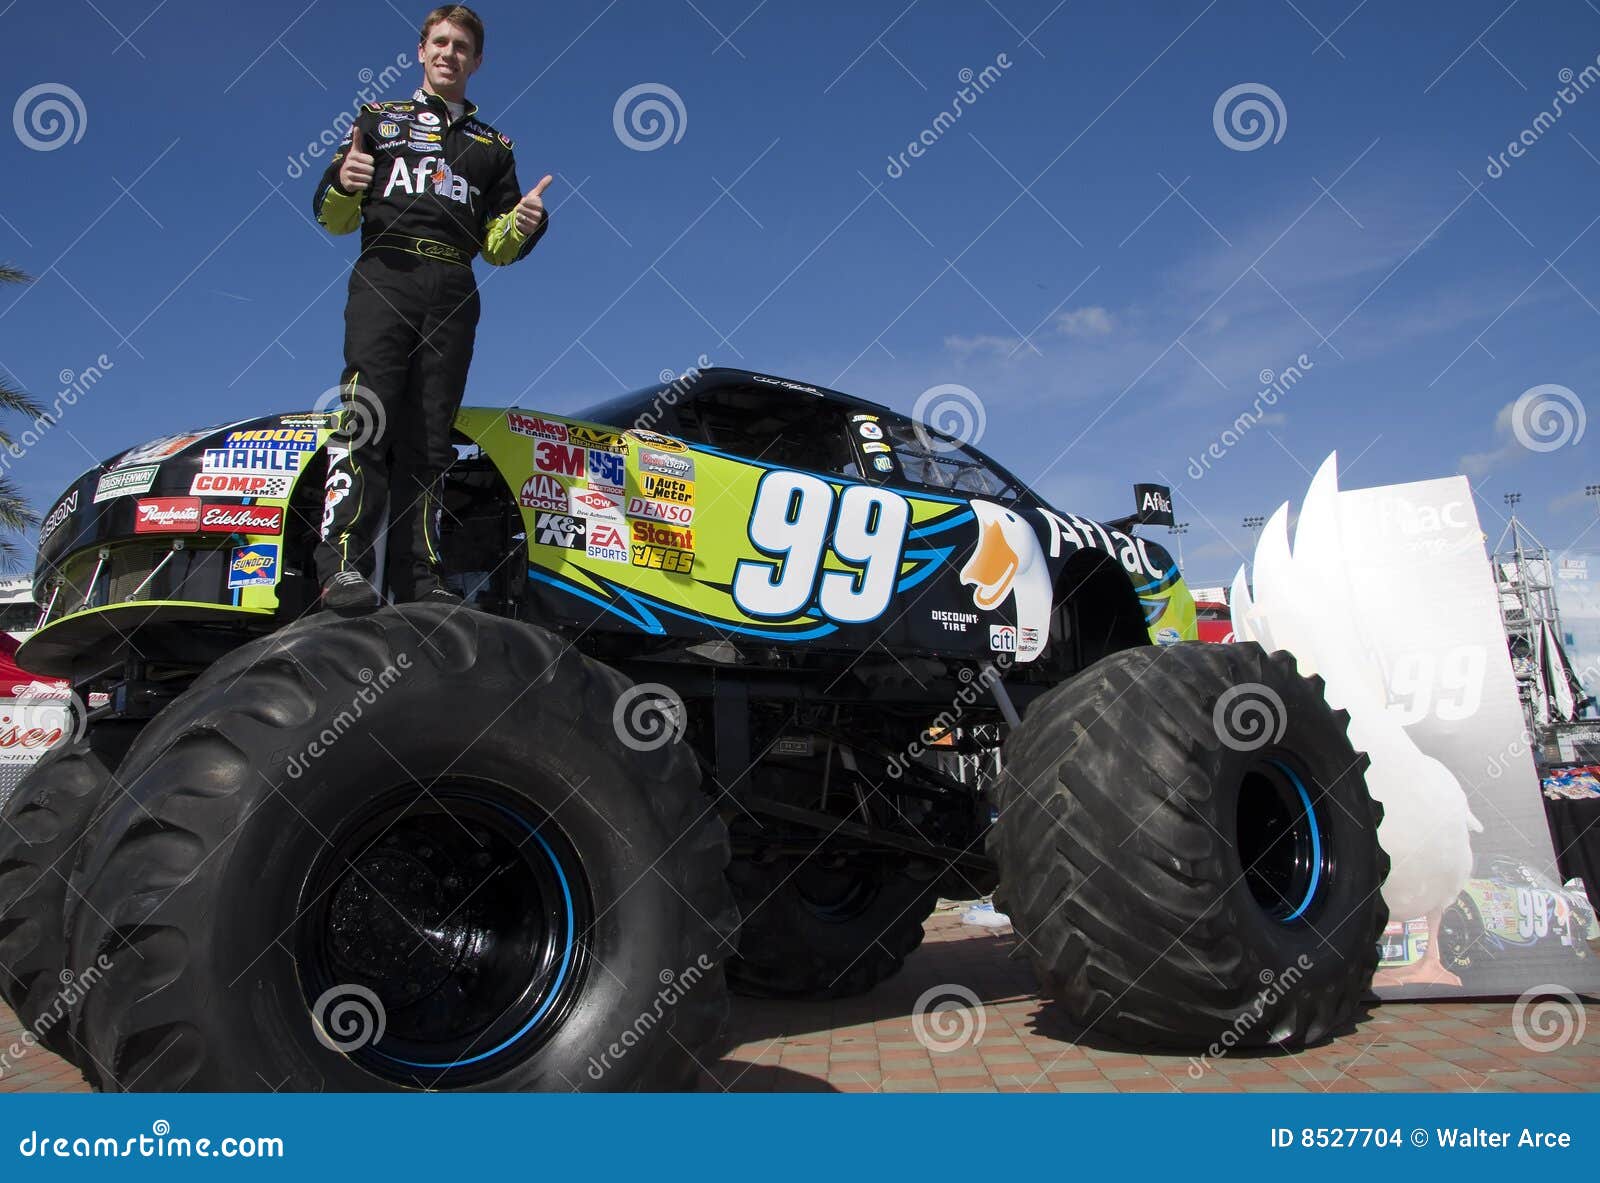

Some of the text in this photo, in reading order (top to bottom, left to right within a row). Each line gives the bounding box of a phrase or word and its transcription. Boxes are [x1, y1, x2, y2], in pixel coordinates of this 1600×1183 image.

[381, 123, 397, 135] RITZ
[226, 429, 316, 442] MOOG
[507, 412, 568, 441] Holley
[228, 441, 311, 451] CHASSIS PARTS
[205, 449, 299, 471] MAHLE
[536, 441, 585, 478] 3M
[589, 449, 625, 487] USG
[666, 459, 691, 472] LIGHT
[196, 475, 266, 490] COMP
[521, 475, 567, 502] MAC
[656, 478, 686, 491] Auto
[521, 497, 568, 511] TOOLS
[655, 487, 692, 502] Meter
[202, 508, 280, 529] Edelbrock
[629, 498, 692, 522] DENSO
[589, 525, 626, 550] EA
[633, 520, 692, 549] Stant
[1036, 507, 1163, 579] Aflac
[588, 546, 627, 561] SPORTS
[733, 470, 910, 622] 99
[234, 557, 272, 569] SUNOCO
[632, 545, 695, 574] JEGS
[931, 610, 978, 624] DISCOUNT
[942, 622, 967, 632] TIRE
[991, 629, 1014, 650] citi
[1518, 887, 1548, 938] 99
